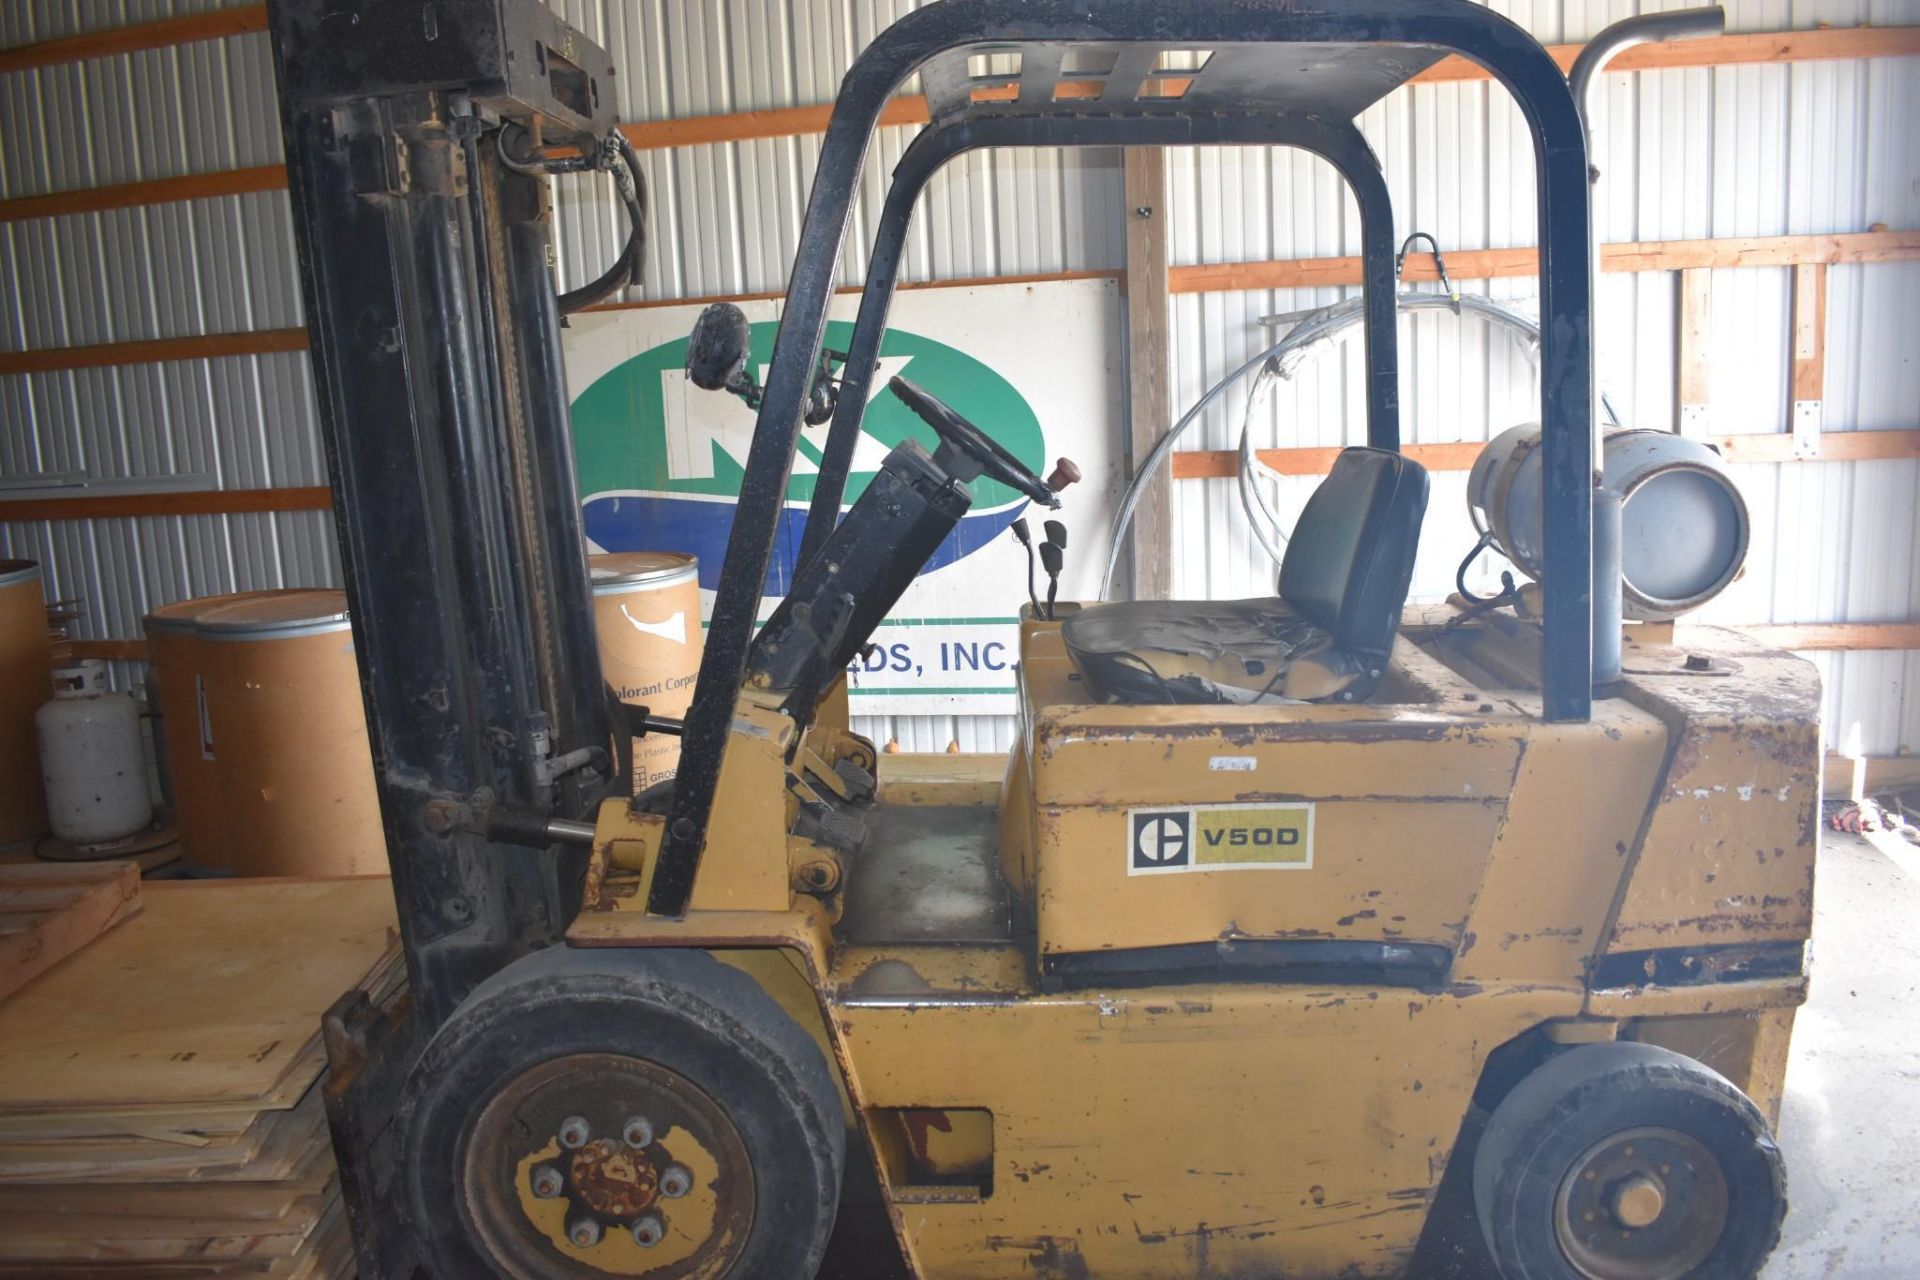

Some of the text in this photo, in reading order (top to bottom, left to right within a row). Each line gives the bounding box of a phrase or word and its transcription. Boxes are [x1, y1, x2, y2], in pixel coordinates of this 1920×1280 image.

[847, 642, 1020, 677] DS, INC.
[1203, 828, 1299, 846] V50D
